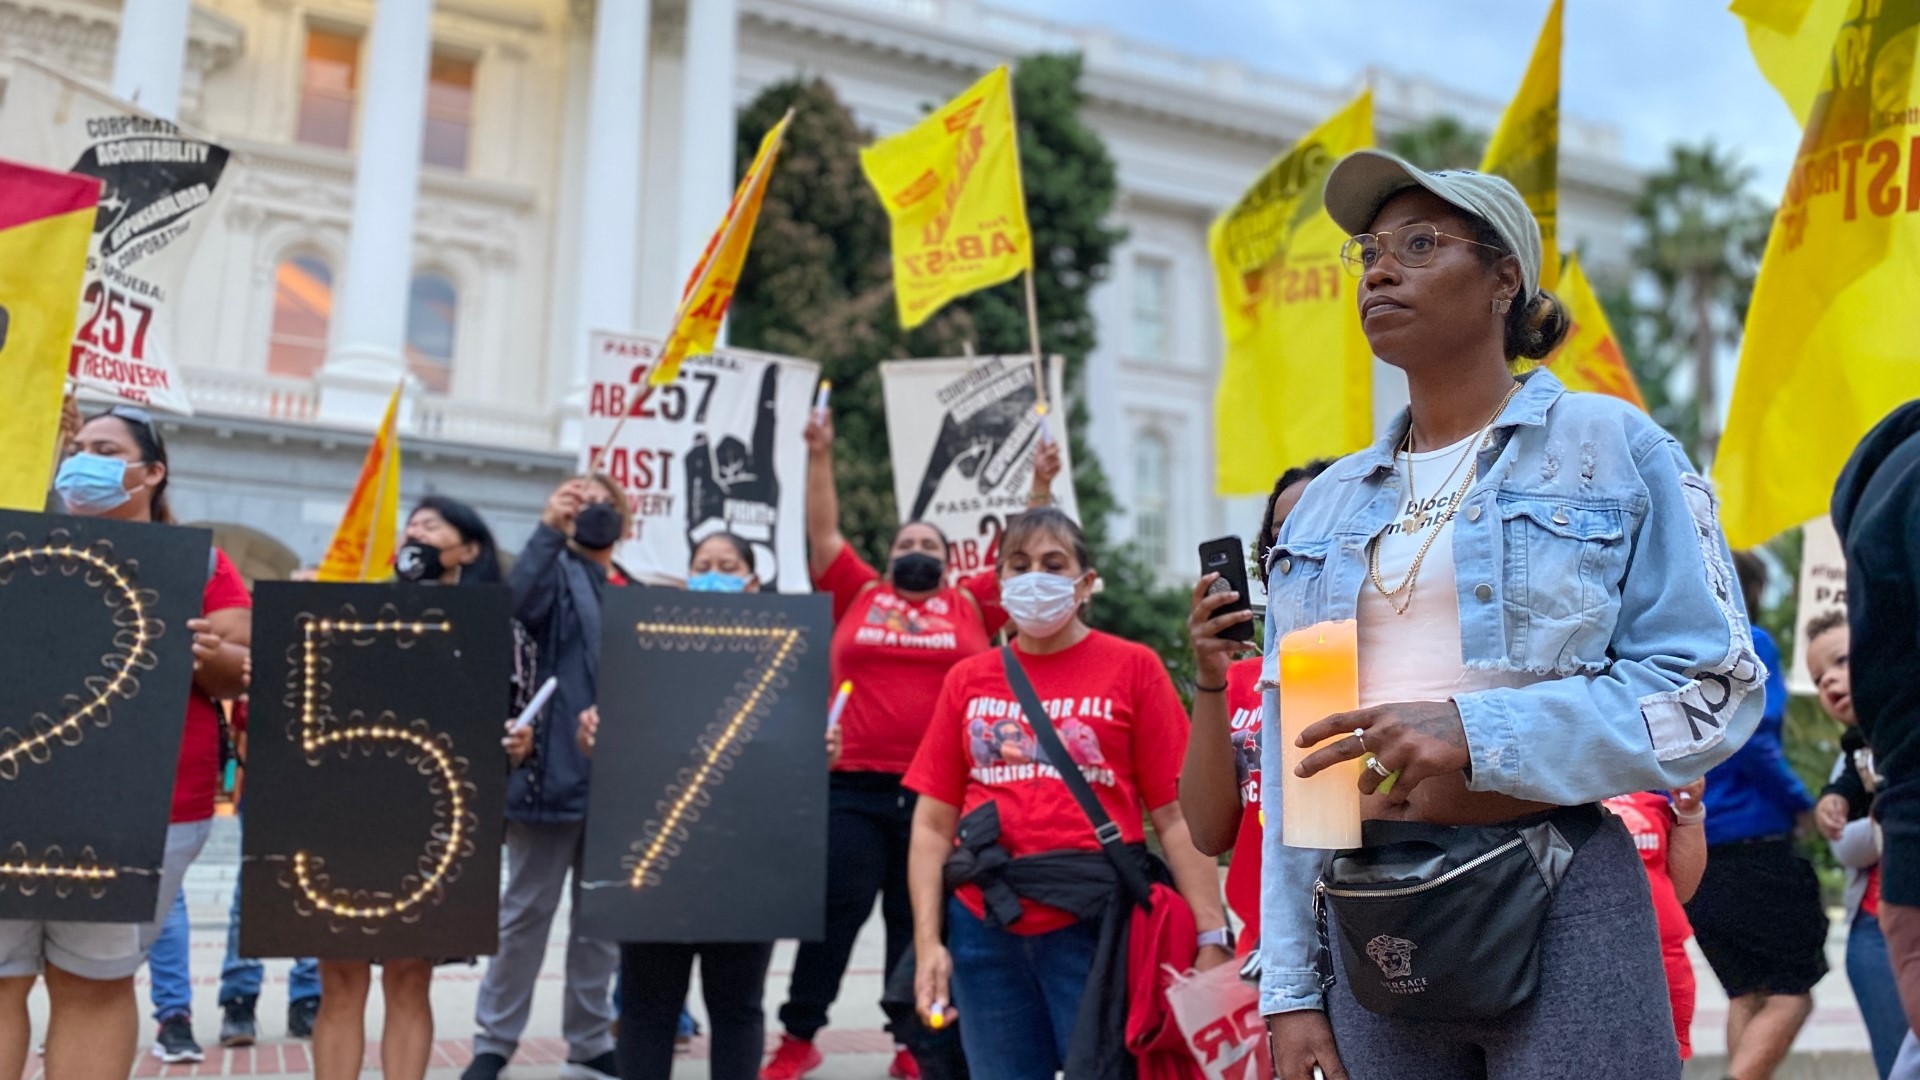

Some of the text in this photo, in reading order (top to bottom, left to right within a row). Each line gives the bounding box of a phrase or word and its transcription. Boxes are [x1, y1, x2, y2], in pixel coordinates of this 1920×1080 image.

[77, 279, 153, 360] 257
[85, 349, 169, 391] RECOVERY
[590, 447, 674, 489] FAST
[1816, 587, 1847, 604] PA
[1078, 697, 1113, 721] ALL
[288, 608, 472, 924] 5
[626, 610, 806, 887] 7
